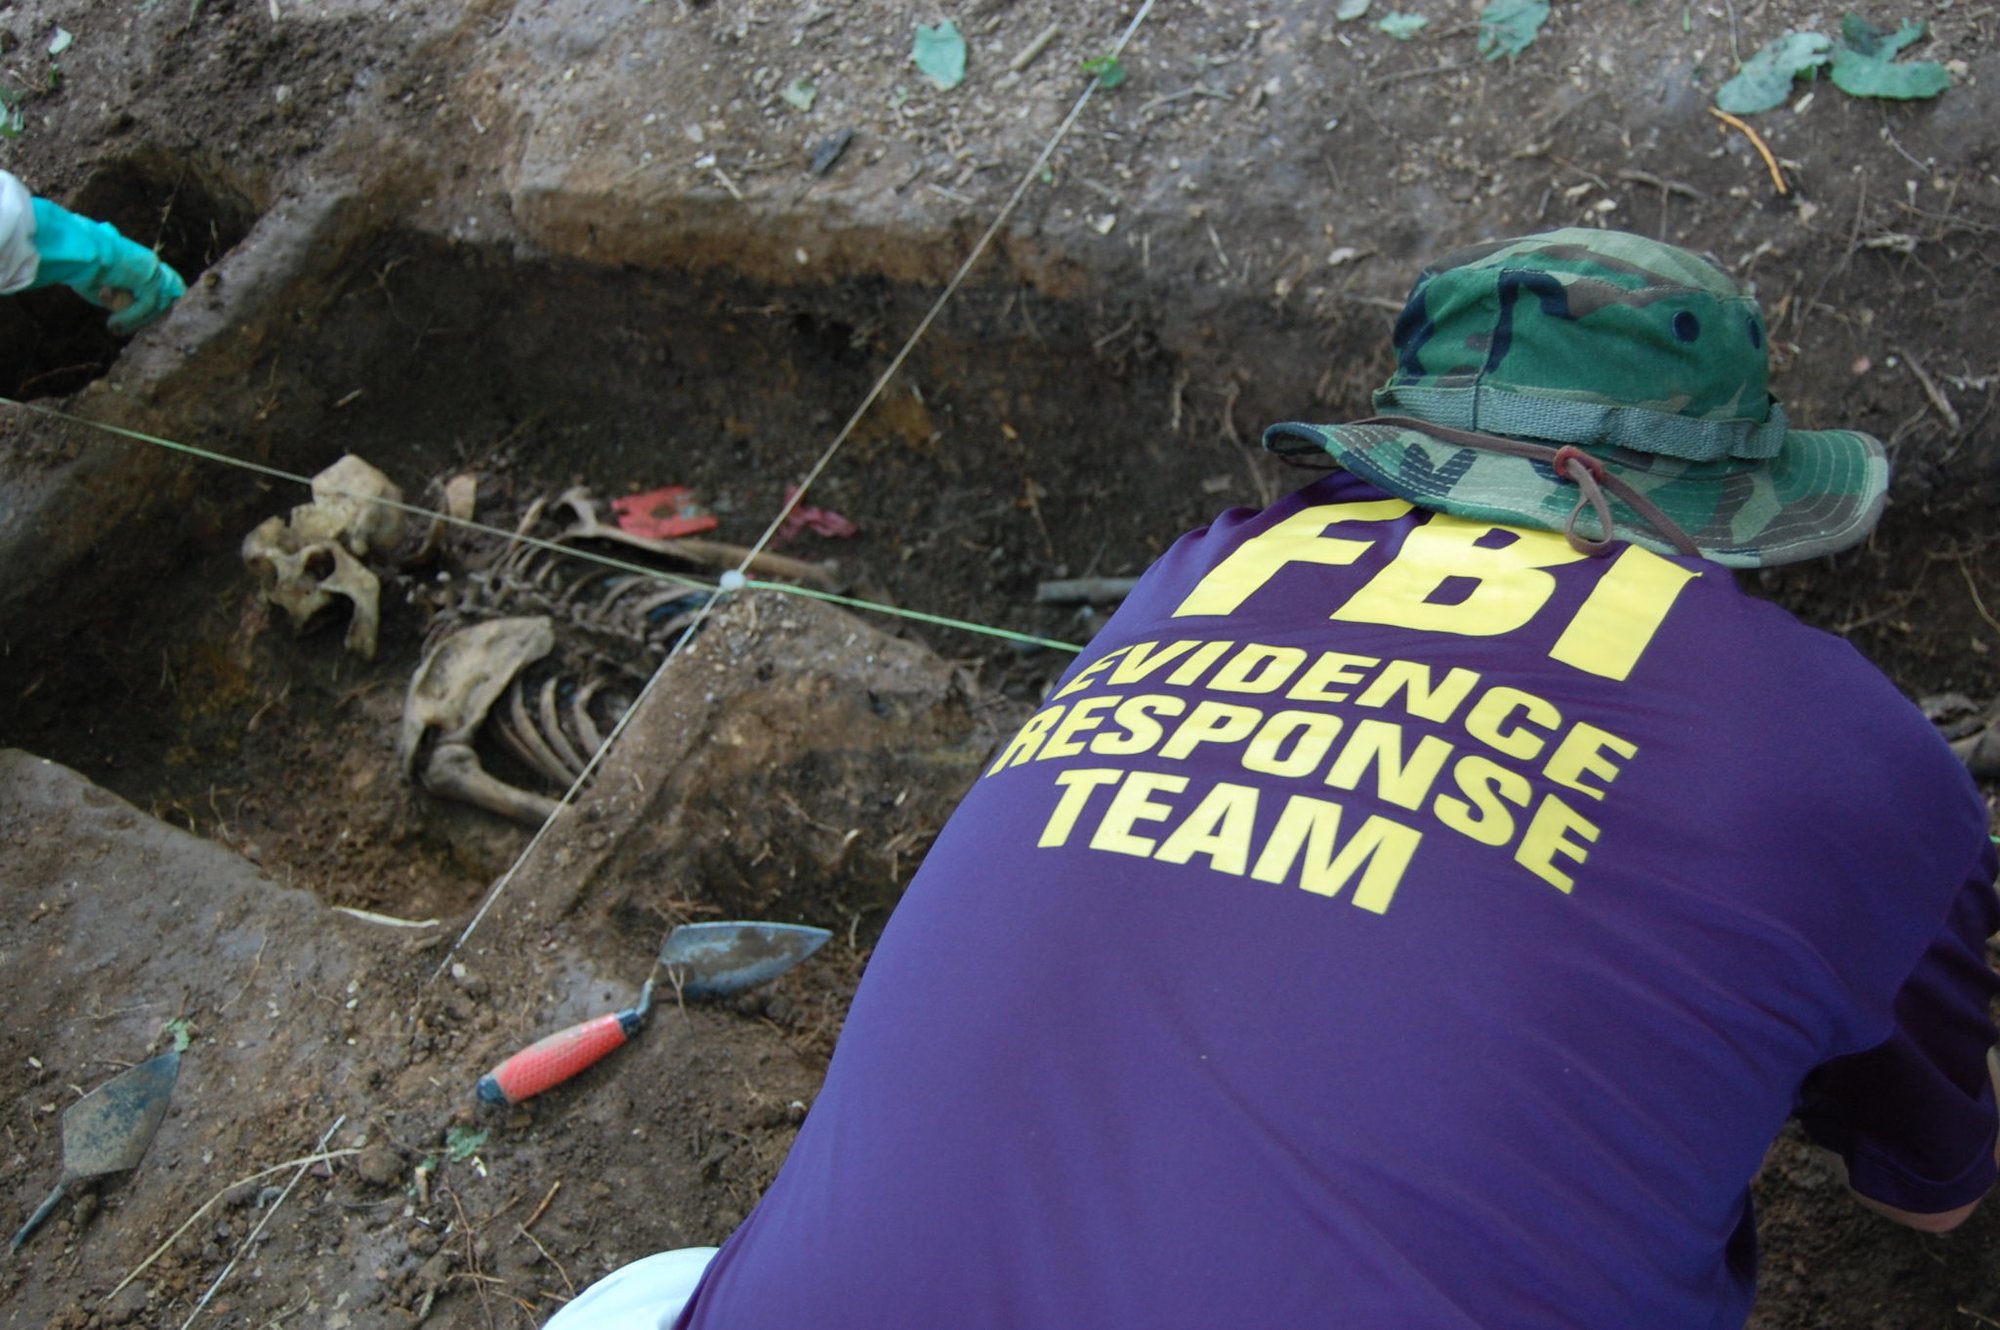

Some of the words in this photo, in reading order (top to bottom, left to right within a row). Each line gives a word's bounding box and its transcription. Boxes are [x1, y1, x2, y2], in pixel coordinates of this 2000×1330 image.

[1173, 499, 1703, 681] FBI
[985, 694, 1601, 894] RESPONSE
[1051, 640, 1638, 800] EVIDENCE
[1038, 768, 1422, 915] TEAM
